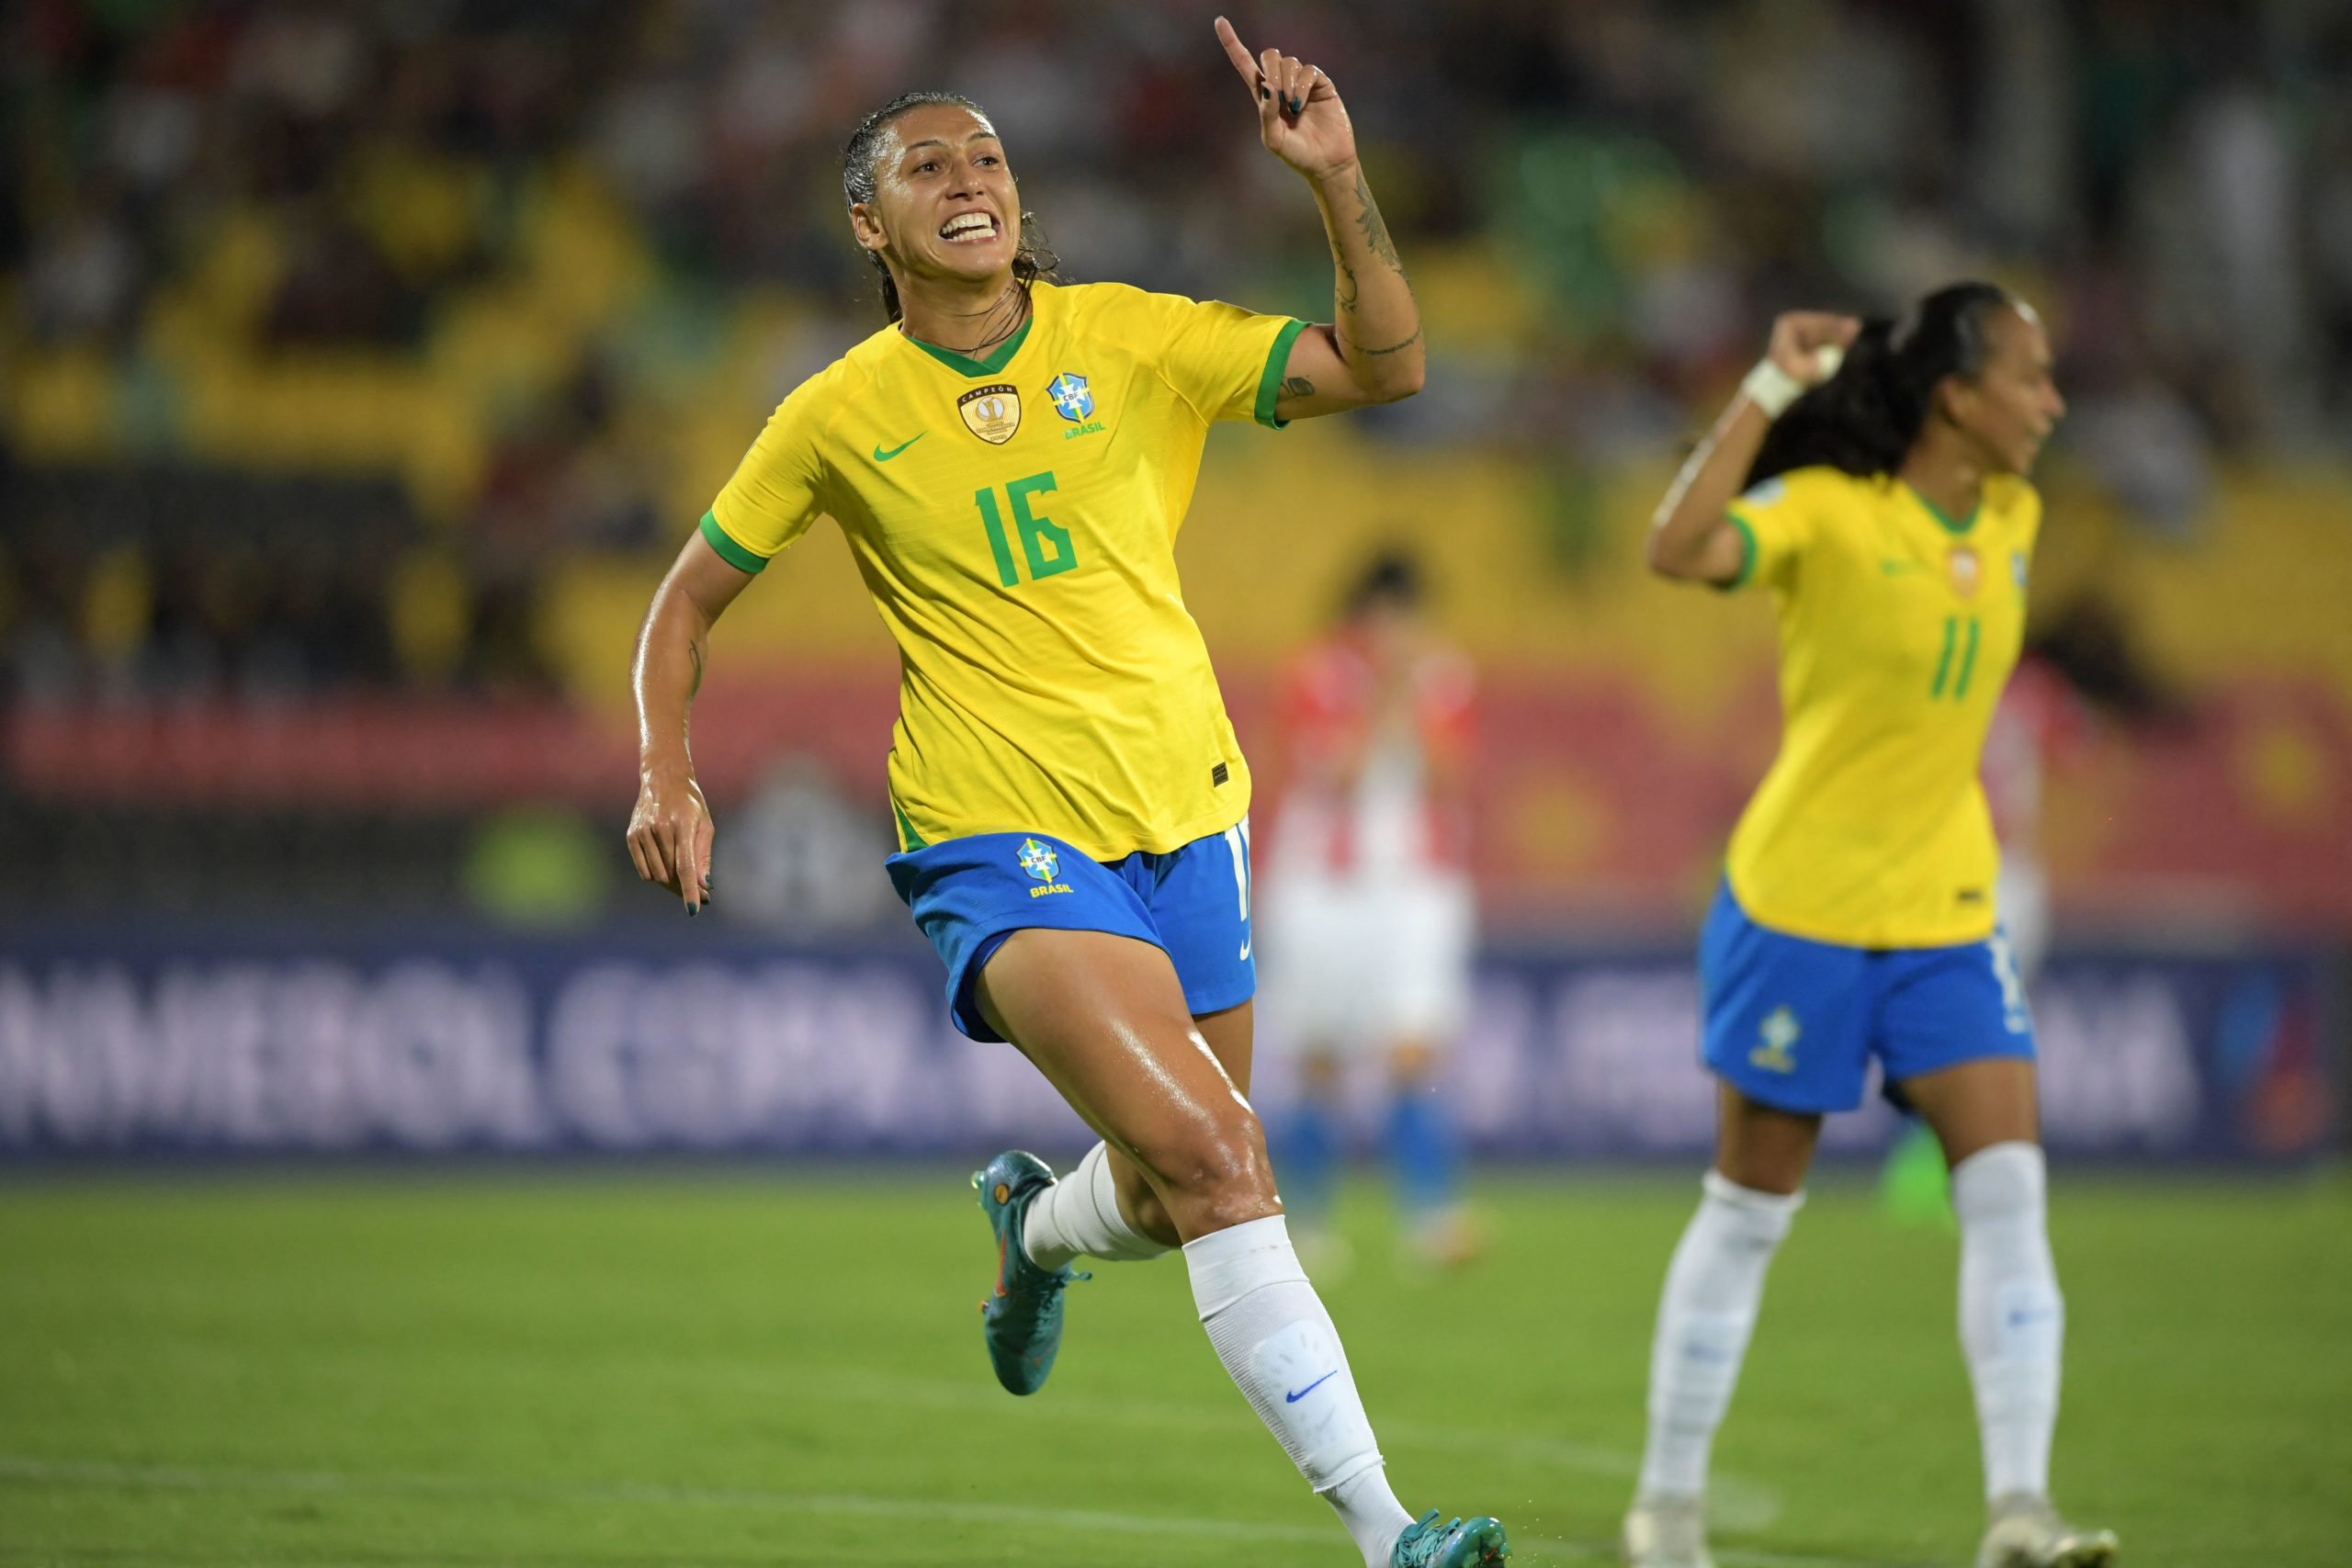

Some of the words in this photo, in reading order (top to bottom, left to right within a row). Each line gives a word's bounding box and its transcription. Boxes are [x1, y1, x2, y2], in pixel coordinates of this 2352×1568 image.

[961, 385, 1013, 402] CAMPEÓN
[1063, 393, 1080, 402] CBF
[1065, 423, 1105, 440] BRASIL
[975, 470, 1078, 588] 16
[1930, 617, 1981, 699] 11
[1030, 855, 1047, 864] CBF
[1030, 884, 1073, 898] BRASIL
